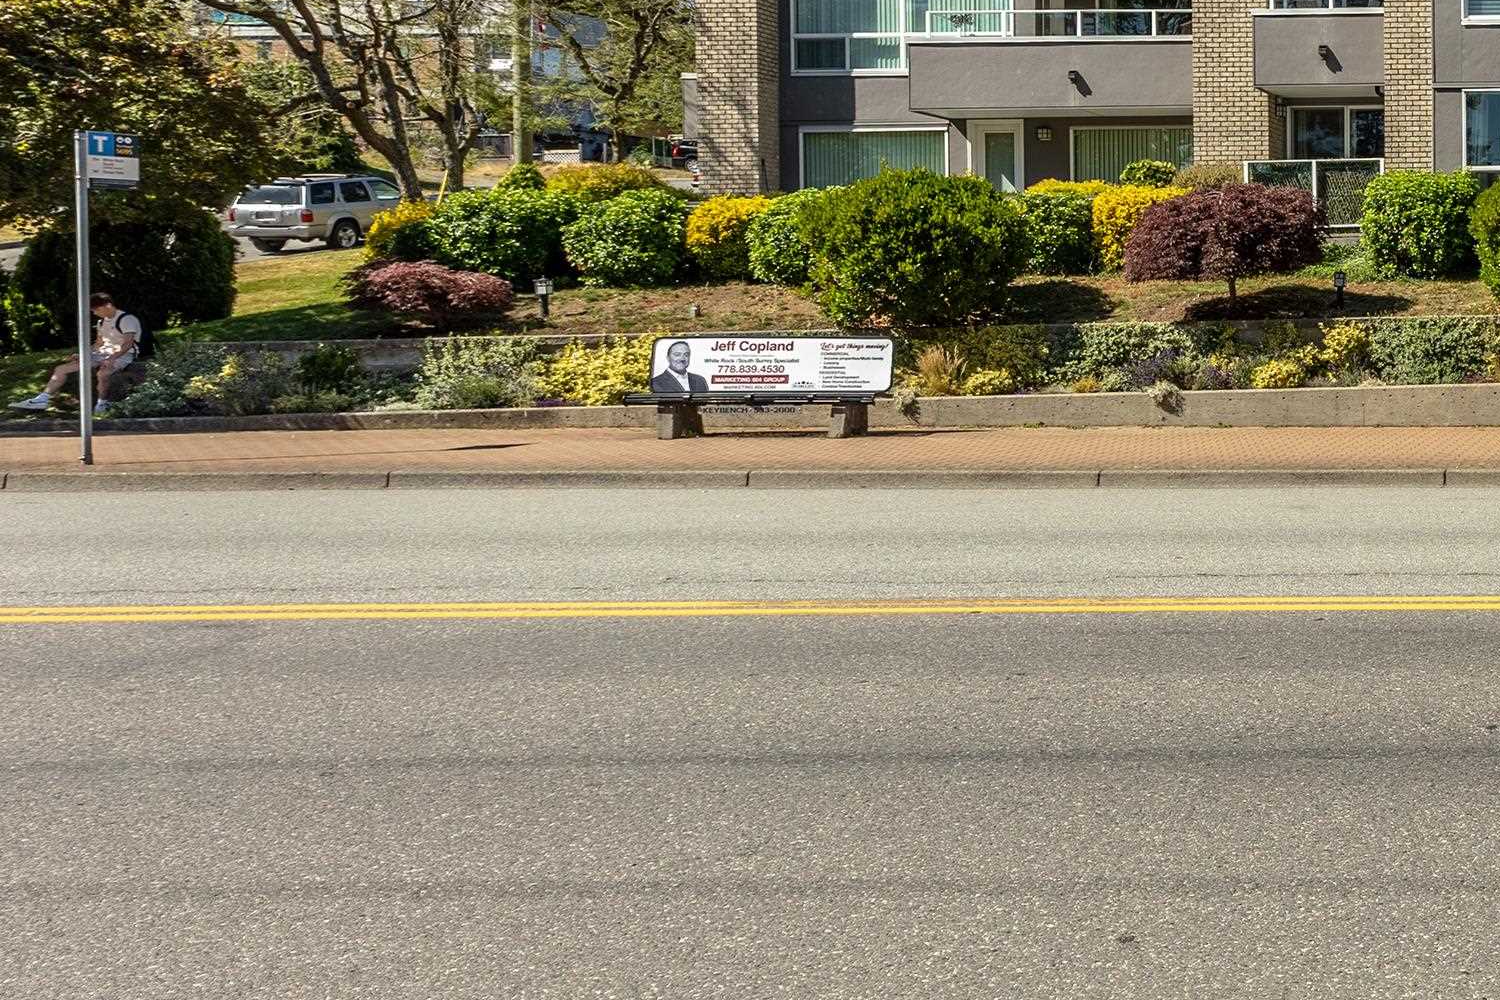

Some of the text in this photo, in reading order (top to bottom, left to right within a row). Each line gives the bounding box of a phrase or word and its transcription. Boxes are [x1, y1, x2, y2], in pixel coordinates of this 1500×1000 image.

[711, 341, 794, 354] Jeff Copland
[718, 365, 785, 374] 778.839.4530
